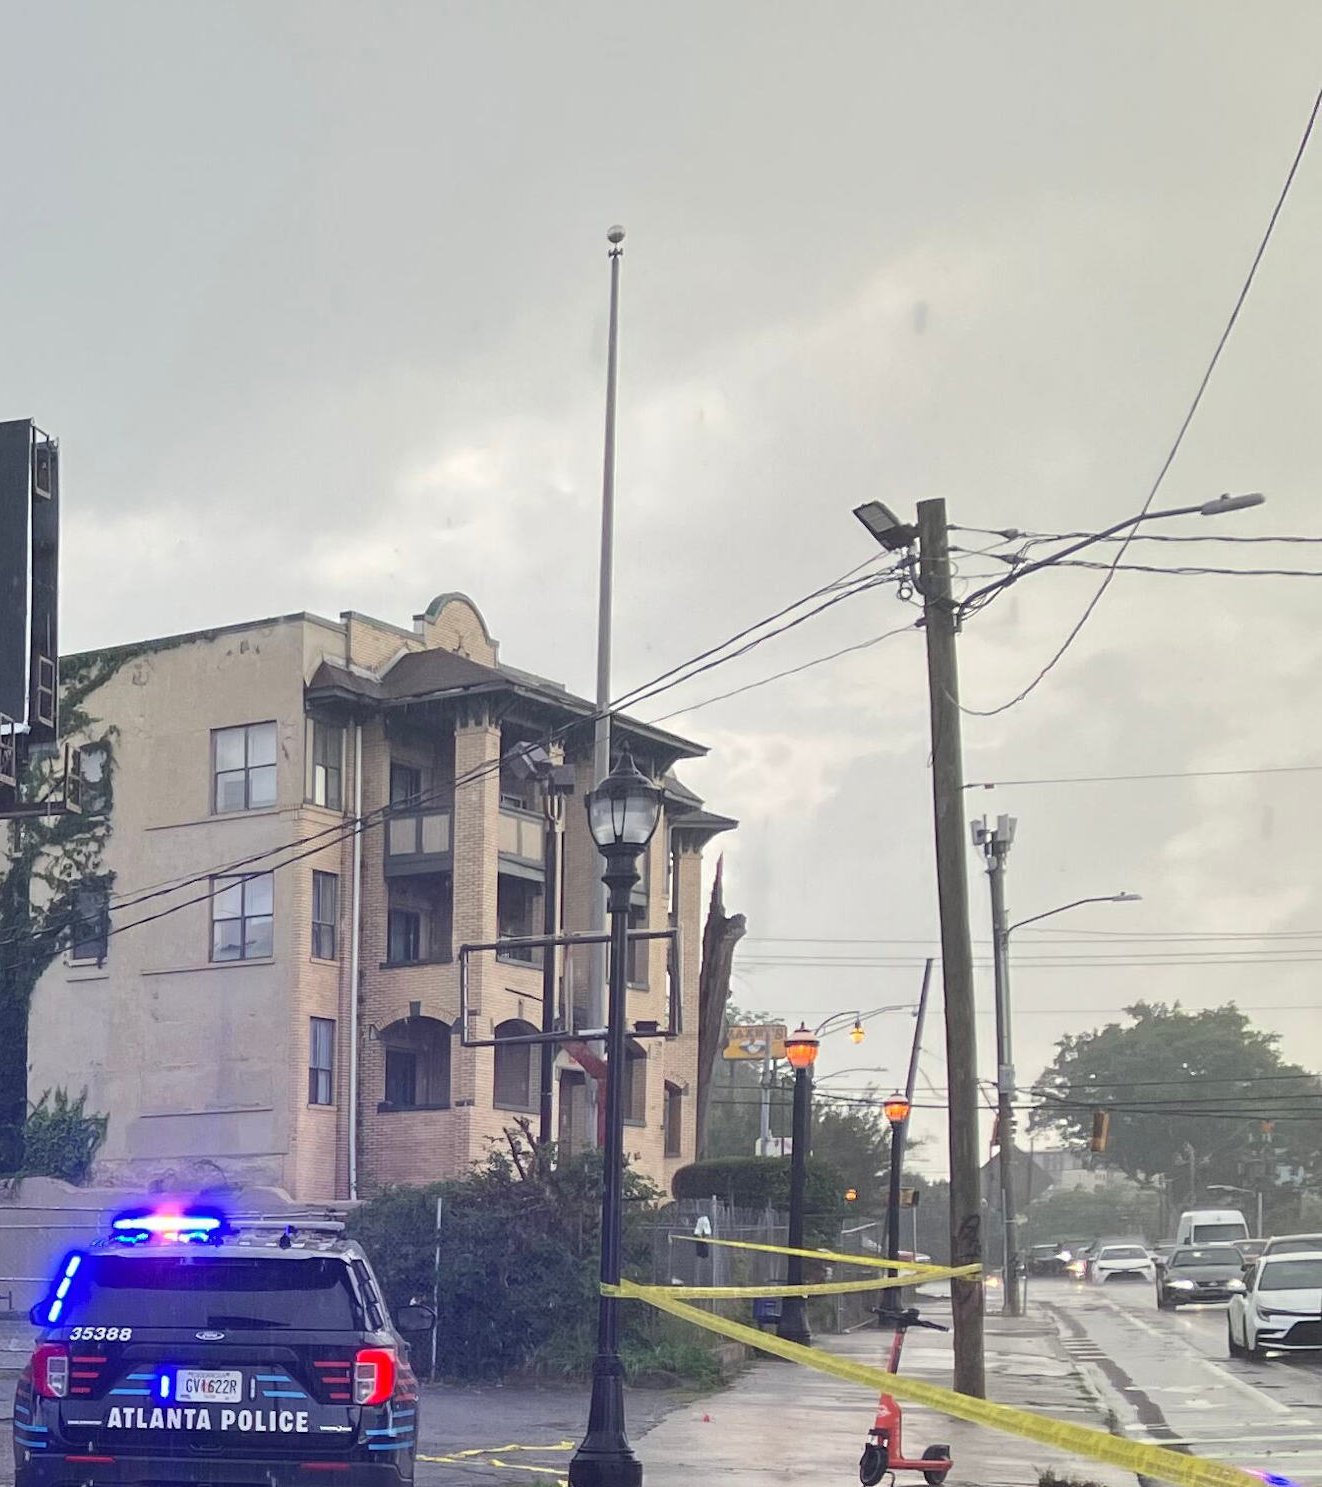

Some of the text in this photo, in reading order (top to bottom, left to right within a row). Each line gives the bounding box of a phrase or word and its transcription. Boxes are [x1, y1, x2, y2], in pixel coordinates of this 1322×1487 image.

[69, 1326, 133, 1342] 35388
[107, 1406, 310, 1433] ATLANTA POLICE
